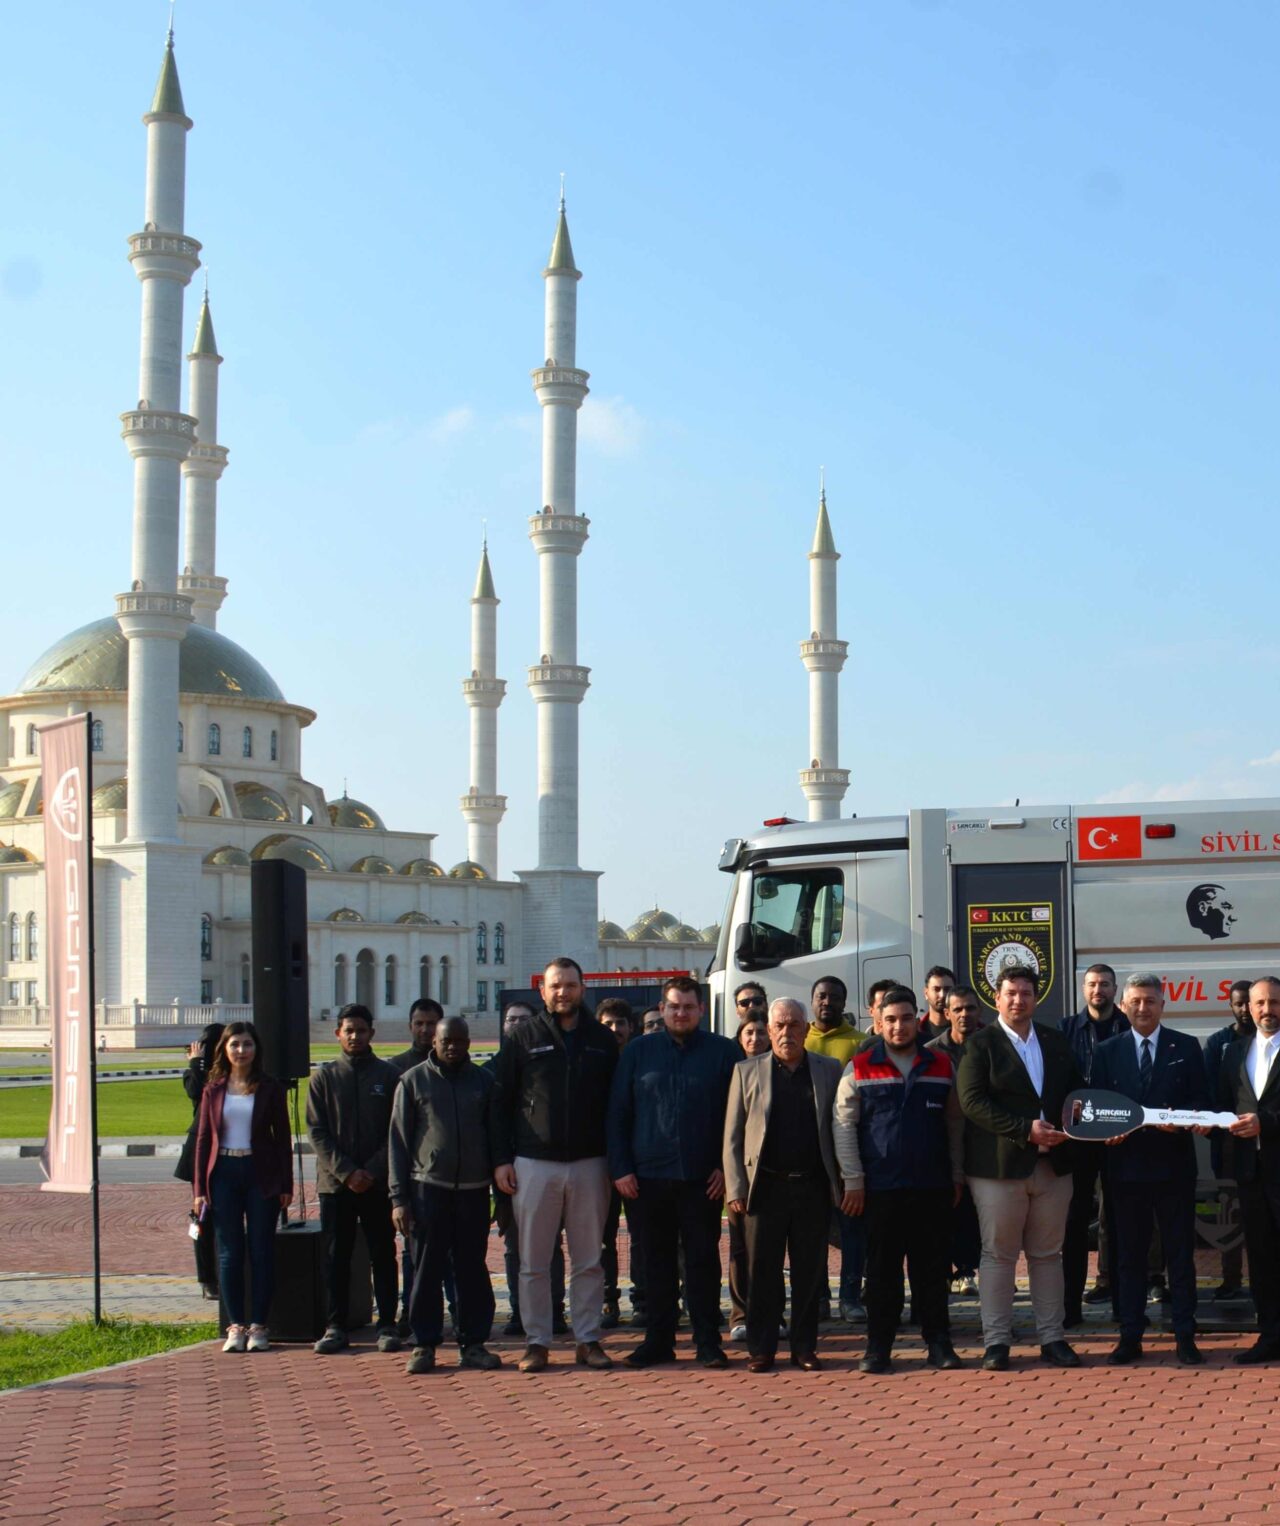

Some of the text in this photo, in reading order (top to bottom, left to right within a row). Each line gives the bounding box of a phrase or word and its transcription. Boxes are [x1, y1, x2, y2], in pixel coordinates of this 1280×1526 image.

[1053, 819, 1067, 830] CE
[1201, 831, 1267, 853] SİVİL
[992, 911, 1029, 922] KKTC
[977, 937, 1000, 973] SEARCH
[1002, 933, 1022, 941] AND
[1023, 937, 1047, 971] RESCUE
